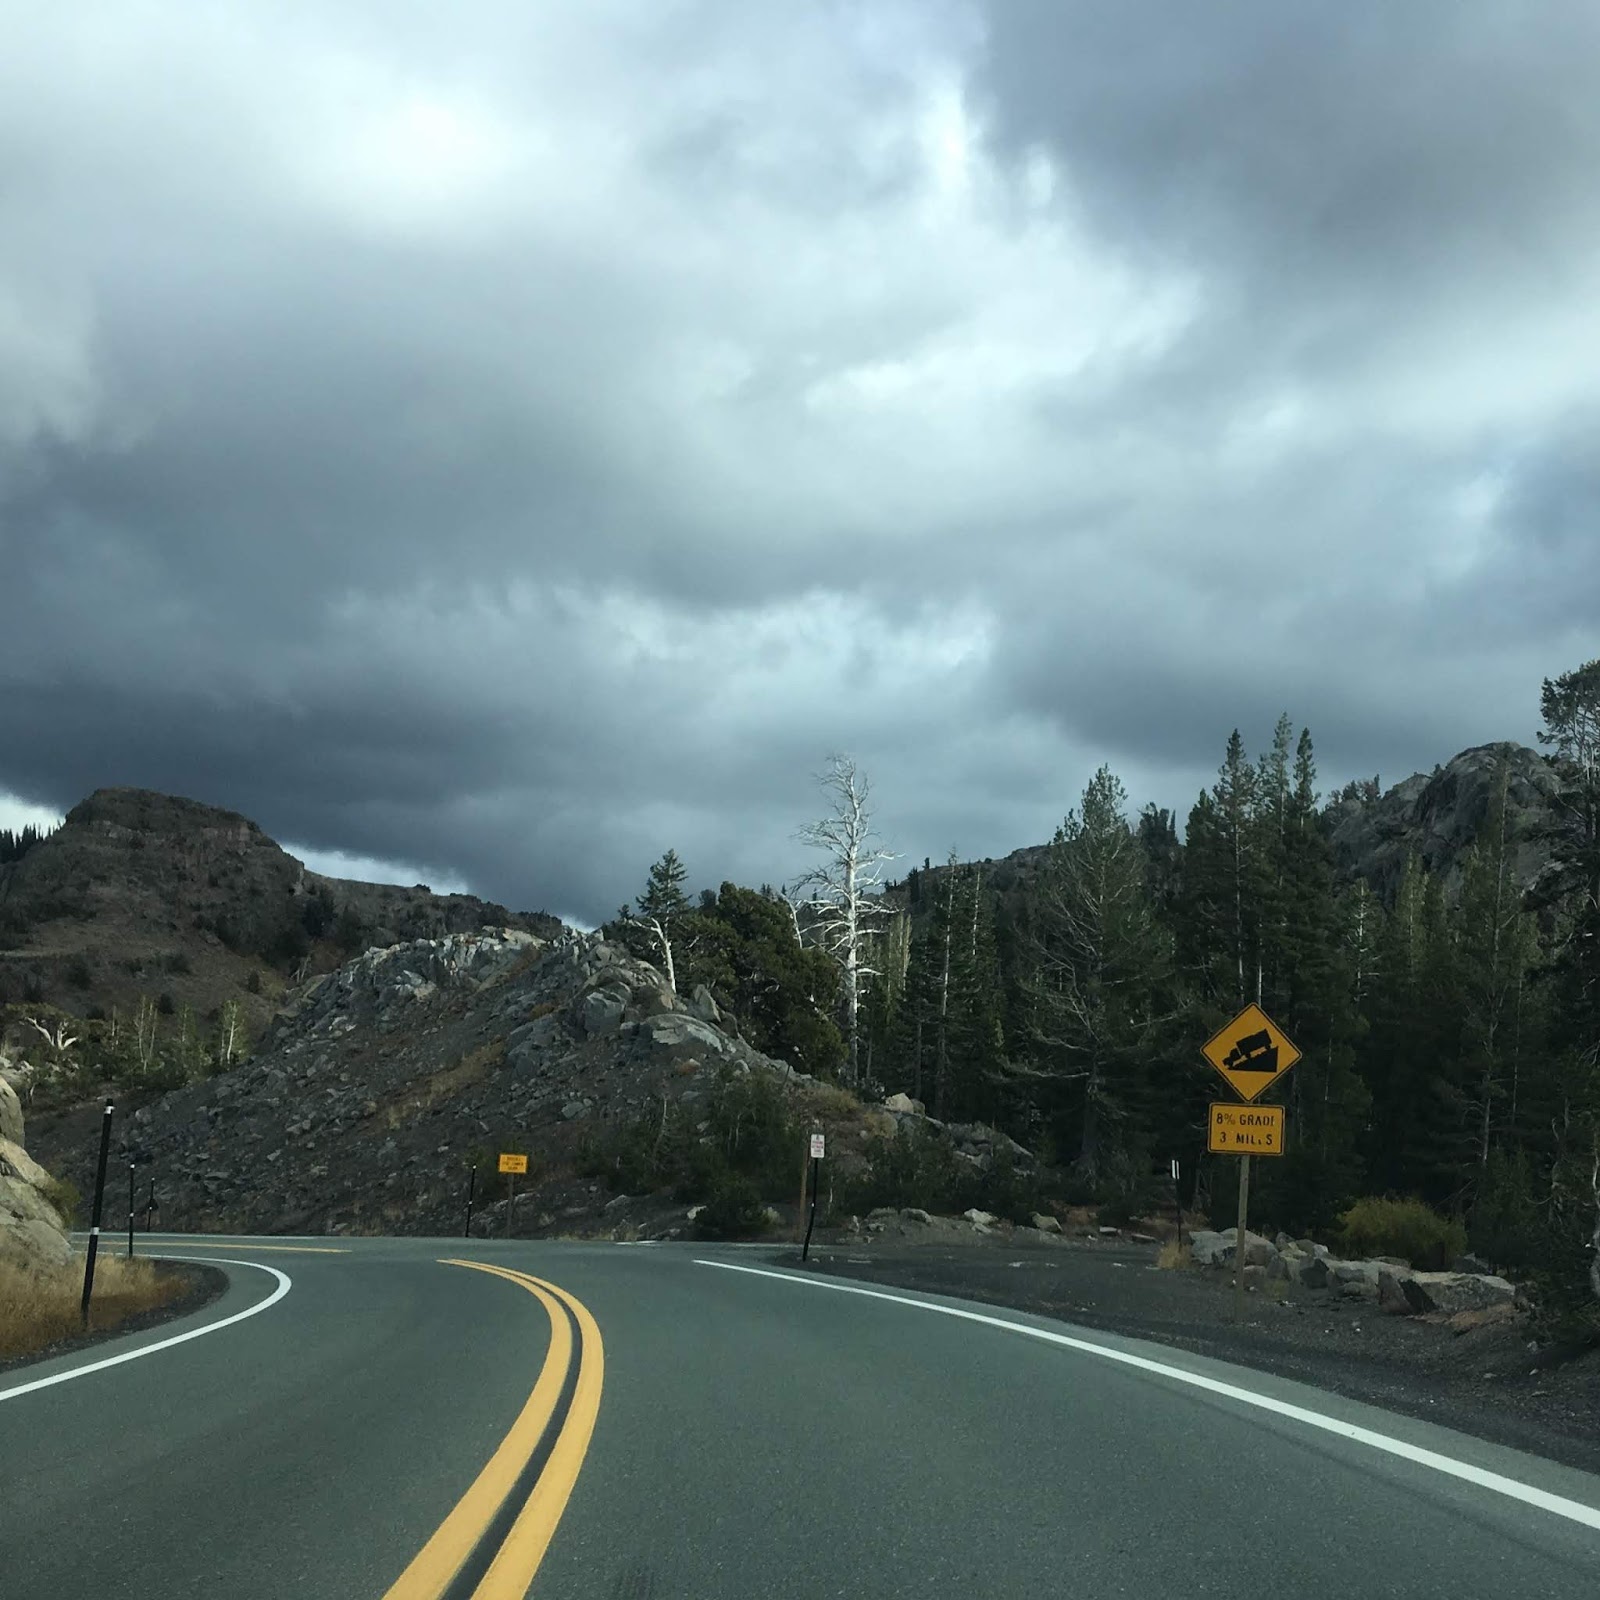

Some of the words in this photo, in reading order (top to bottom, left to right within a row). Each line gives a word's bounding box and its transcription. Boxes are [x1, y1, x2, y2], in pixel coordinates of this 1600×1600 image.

[1216, 1112, 1236, 1126] 8%
[1220, 1131, 1227, 1143] 3
[1235, 1132, 1273, 1146] MILS
